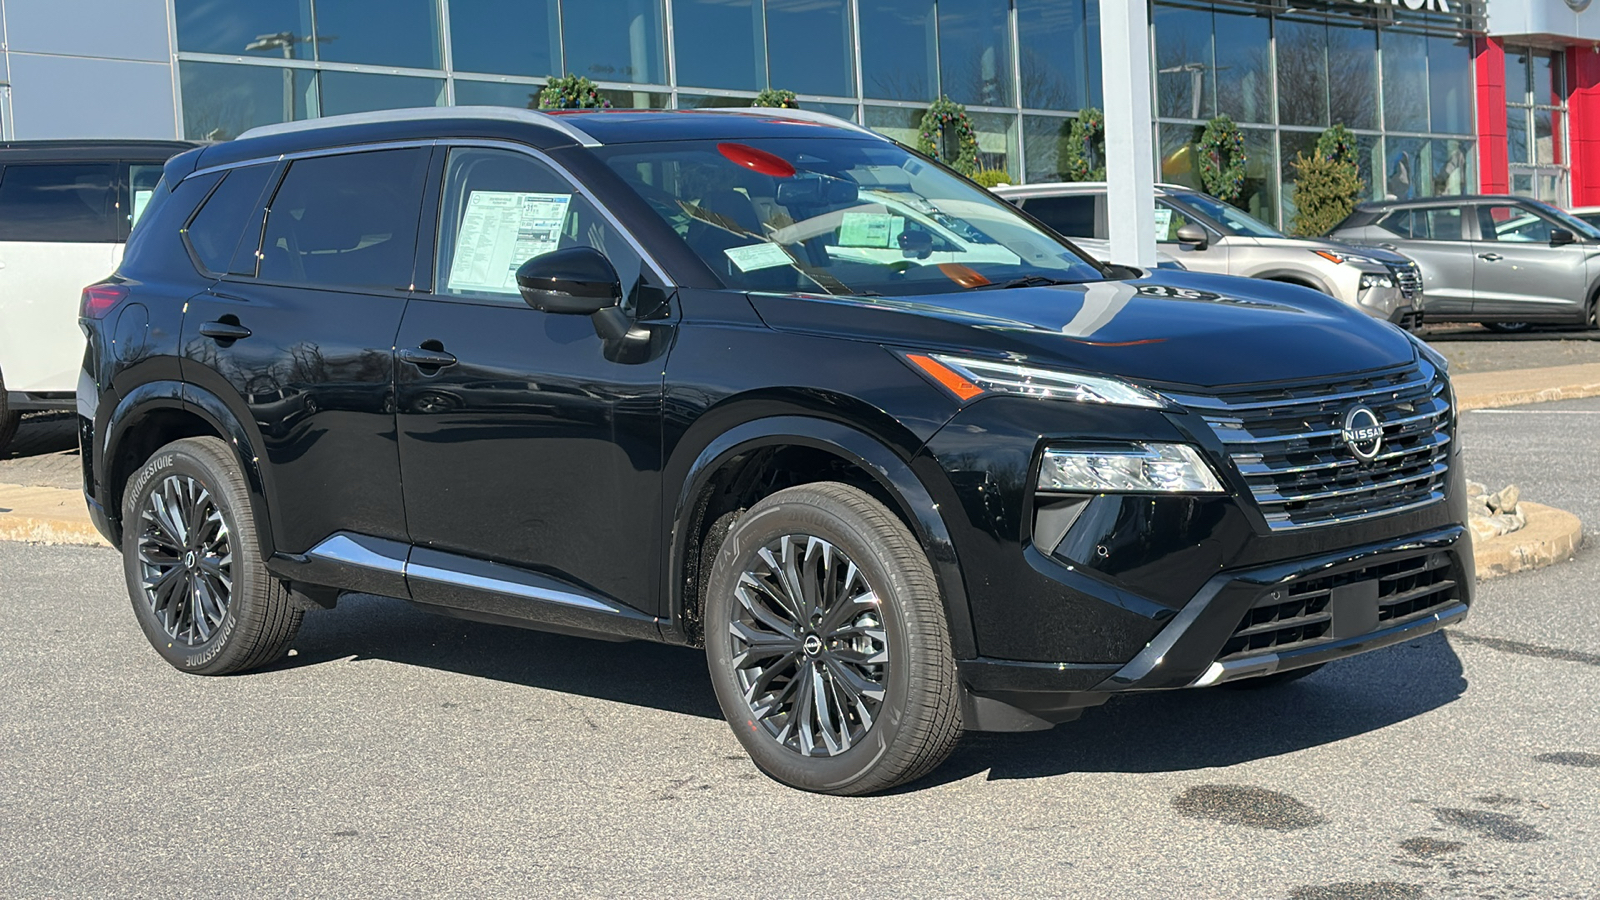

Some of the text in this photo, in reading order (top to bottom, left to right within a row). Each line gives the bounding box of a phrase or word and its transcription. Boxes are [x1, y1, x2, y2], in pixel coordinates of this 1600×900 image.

[1342, 426, 1384, 442] NISSAN
[128, 455, 173, 512] BRIDGESTONE
[186, 612, 236, 666] BRIDGESTONE
